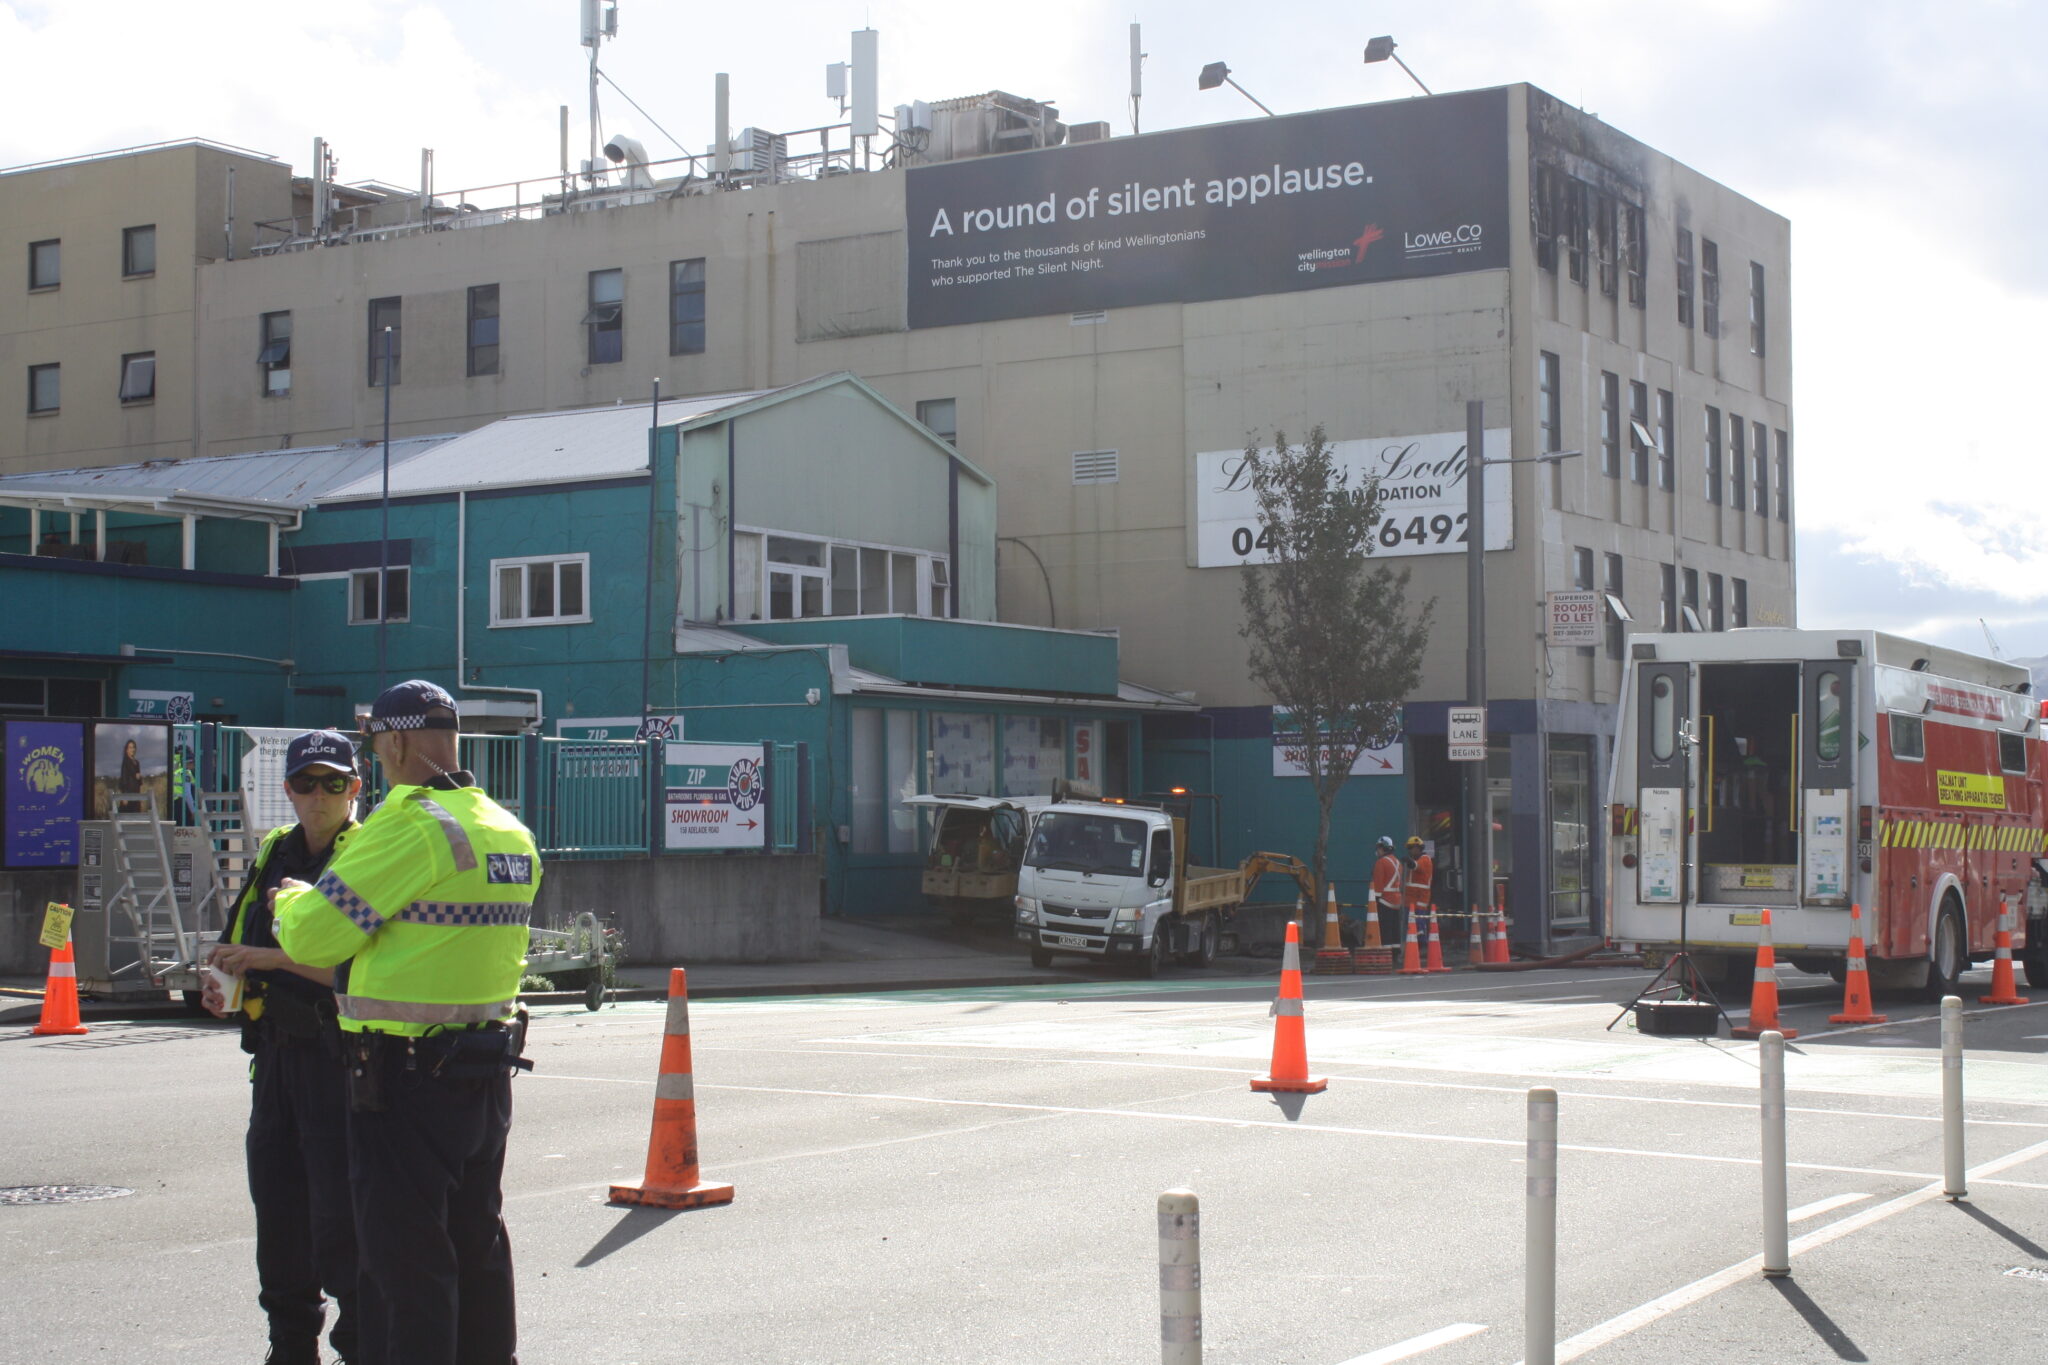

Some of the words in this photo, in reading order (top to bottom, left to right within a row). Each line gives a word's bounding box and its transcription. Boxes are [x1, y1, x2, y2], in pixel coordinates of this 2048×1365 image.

[930, 208, 953, 237] A
[963, 193, 1055, 233] round
[1066, 187, 1099, 220] of
[1108, 178, 1195, 215] silent
[1205, 162, 1373, 207] applause.
[931, 256, 963, 269] Thank
[966, 255, 985, 267] you
[989, 252, 1000, 262] to
[1003, 249, 1021, 261] the
[1024, 243, 1079, 259] thousands
[1083, 241, 1095, 252] of
[1098, 238, 1121, 251] kind
[1126, 229, 1206, 249] Wellingtonians
[1298, 248, 1350, 261] wellington
[931, 273, 954, 287] who
[957, 269, 1011, 285] supported
[1015, 265, 1034, 277] The
[1038, 261, 1067, 275] Silent
[1071, 258, 1104, 272] Night.
[1379, 442, 1468, 489] Lodg
[1553, 603, 1594, 612] ROOMS
[1553, 613, 1570, 622] TO
[1574, 613, 1593, 622] LET
[136, 700, 155, 713] ZIP
[259, 736, 277, 746] We're
[587, 729, 608, 740] ZIP
[1453, 730, 1478, 739] LANE
[22, 745, 65, 766] WOMEN
[259, 747, 271, 756] the
[272, 748, 287, 758] gree
[301, 746, 337, 757] POLICE
[1452, 749, 1480, 757] BEGINS
[687, 768, 706, 785] ZIP
[729, 760, 760, 789] PLUMBING
[1939, 774, 1957, 786] HAZMAT
[1957, 776, 1967, 788] UNIT
[735, 794, 754, 810] PLUS
[1940, 788, 1964, 802] BREATHING
[1964, 791, 1988, 804] APPARATUS
[1988, 793, 2003, 805] TENDER
[671, 809, 729, 823] SHOWROOM
[688, 826, 709, 834] ADELAIDE
[488, 860, 529, 878] POLICE
[50, 904, 72, 917] CAUTION
